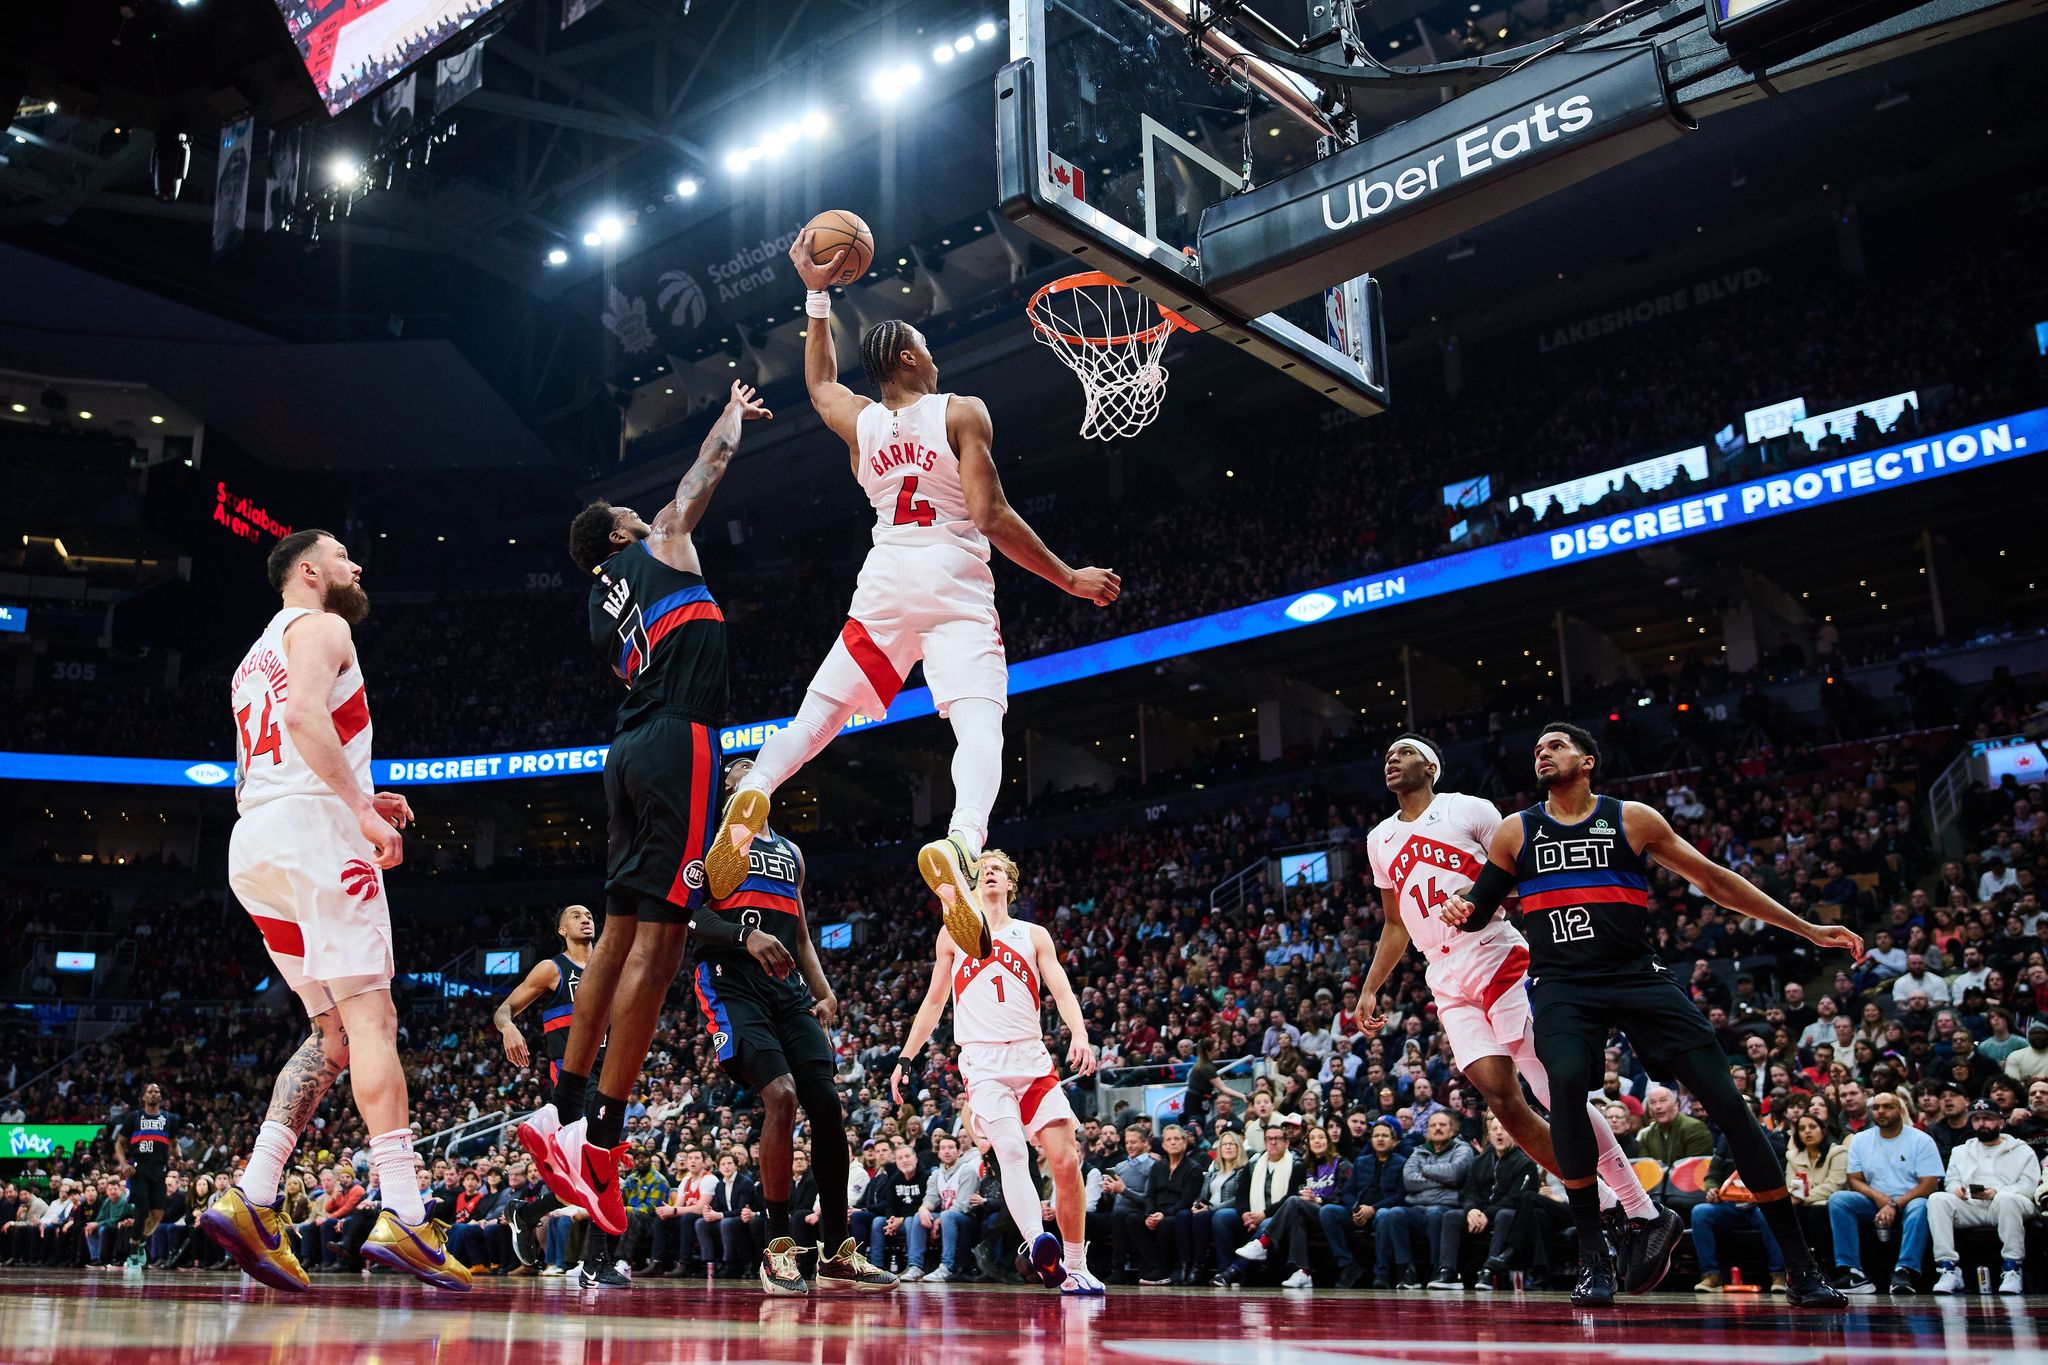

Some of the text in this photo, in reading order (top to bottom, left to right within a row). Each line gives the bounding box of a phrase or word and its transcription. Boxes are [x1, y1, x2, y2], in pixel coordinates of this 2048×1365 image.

[1322, 95, 1593, 230] Uber Eats
[717, 264, 776, 304] Arena
[1538, 266, 1772, 353] LAKESHORE BLVD.
[870, 442, 938, 477] BARNES
[893, 476, 936, 527] 4
[1550, 493, 1728, 560] DISCREET
[1741, 423, 2027, 514] PROTECTION.
[213, 502, 260, 545] Arena
[526, 572, 563, 588] 306
[1342, 576, 1405, 608] MEN
[617, 602, 650, 675] 7
[52, 661, 97, 681] 305
[237, 690, 282, 777] 54
[389, 757, 501, 781] DISCREET
[1535, 838, 1614, 873] DET
[1409, 876, 1449, 919] 14
[1548, 906, 1595, 943] 12
[963, 946, 1028, 983] RATORS
[990, 974, 1006, 1003] 1
[10, 1133, 53, 1156] MAX
[139, 1140, 154, 1153] 31
